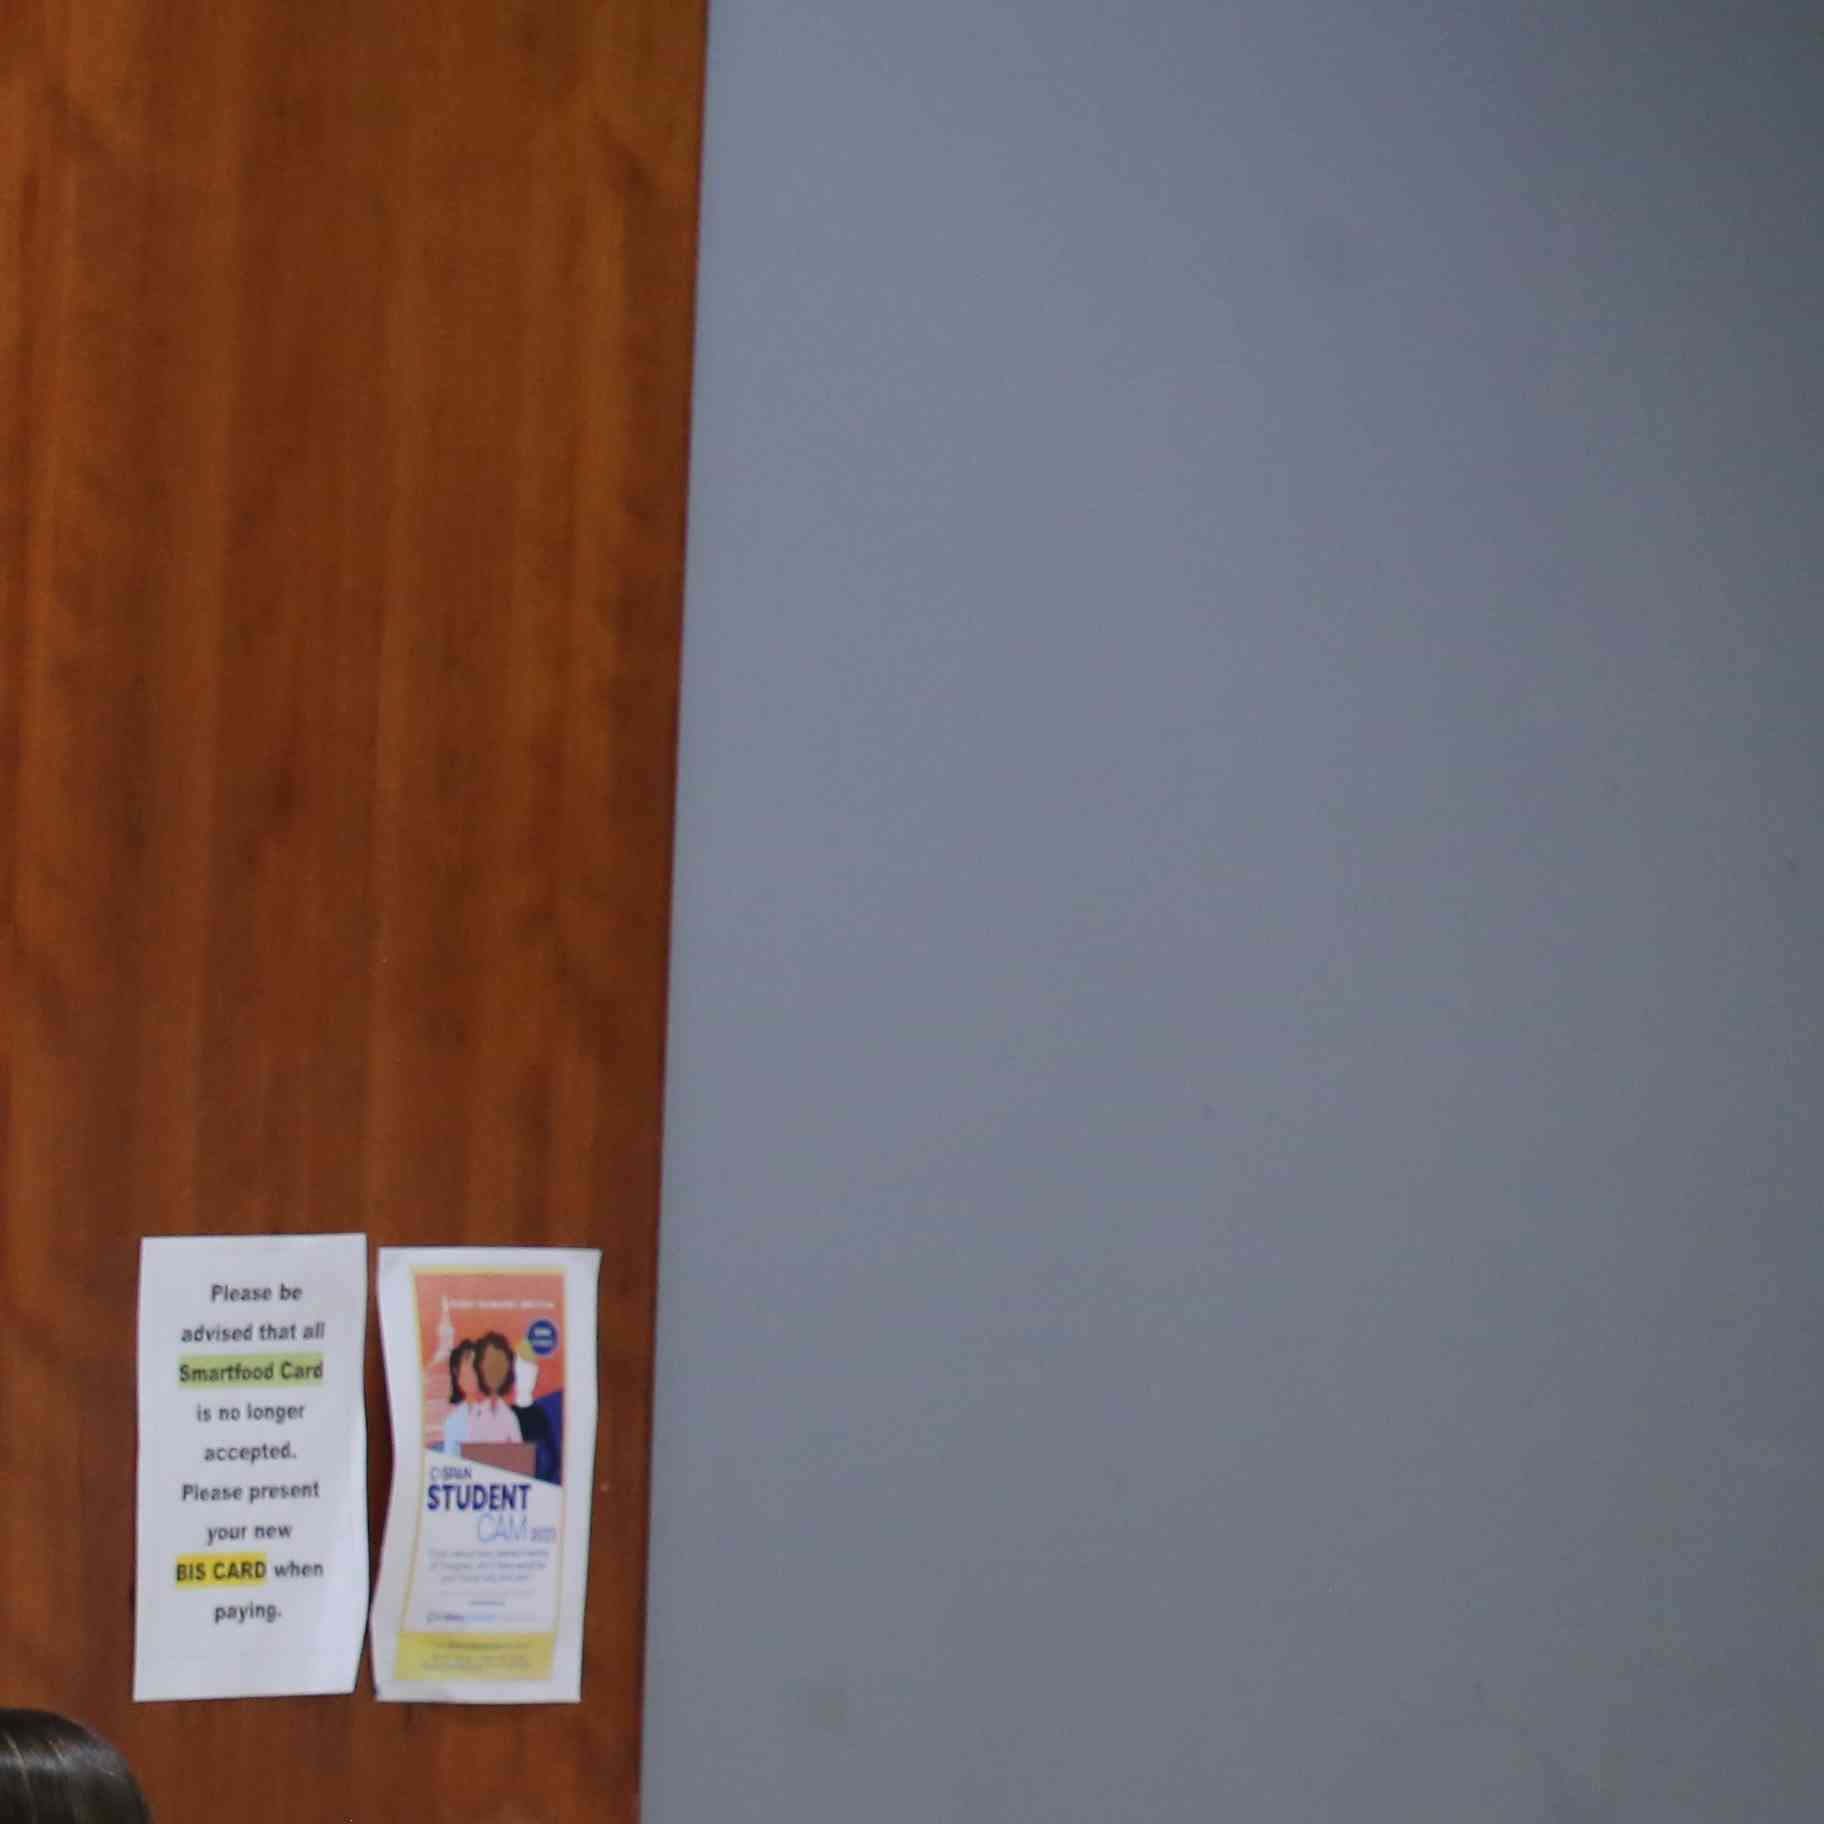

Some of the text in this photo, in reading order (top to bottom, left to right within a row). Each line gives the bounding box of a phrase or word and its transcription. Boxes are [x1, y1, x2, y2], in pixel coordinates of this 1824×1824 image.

[210, 1283, 303, 1302] Please be
[181, 1321, 326, 1343] advised that all
[179, 1361, 324, 1383] Smartfood Card
[196, 1402, 305, 1424] is no longer
[204, 1442, 297, 1465] accepted.
[182, 1482, 320, 1504] Please present
[427, 1484, 531, 1511] STUDENT
[207, 1525, 293, 1546] your new
[176, 1560, 324, 1582] BIS CARD when
[214, 1602, 282, 1624] paying.
